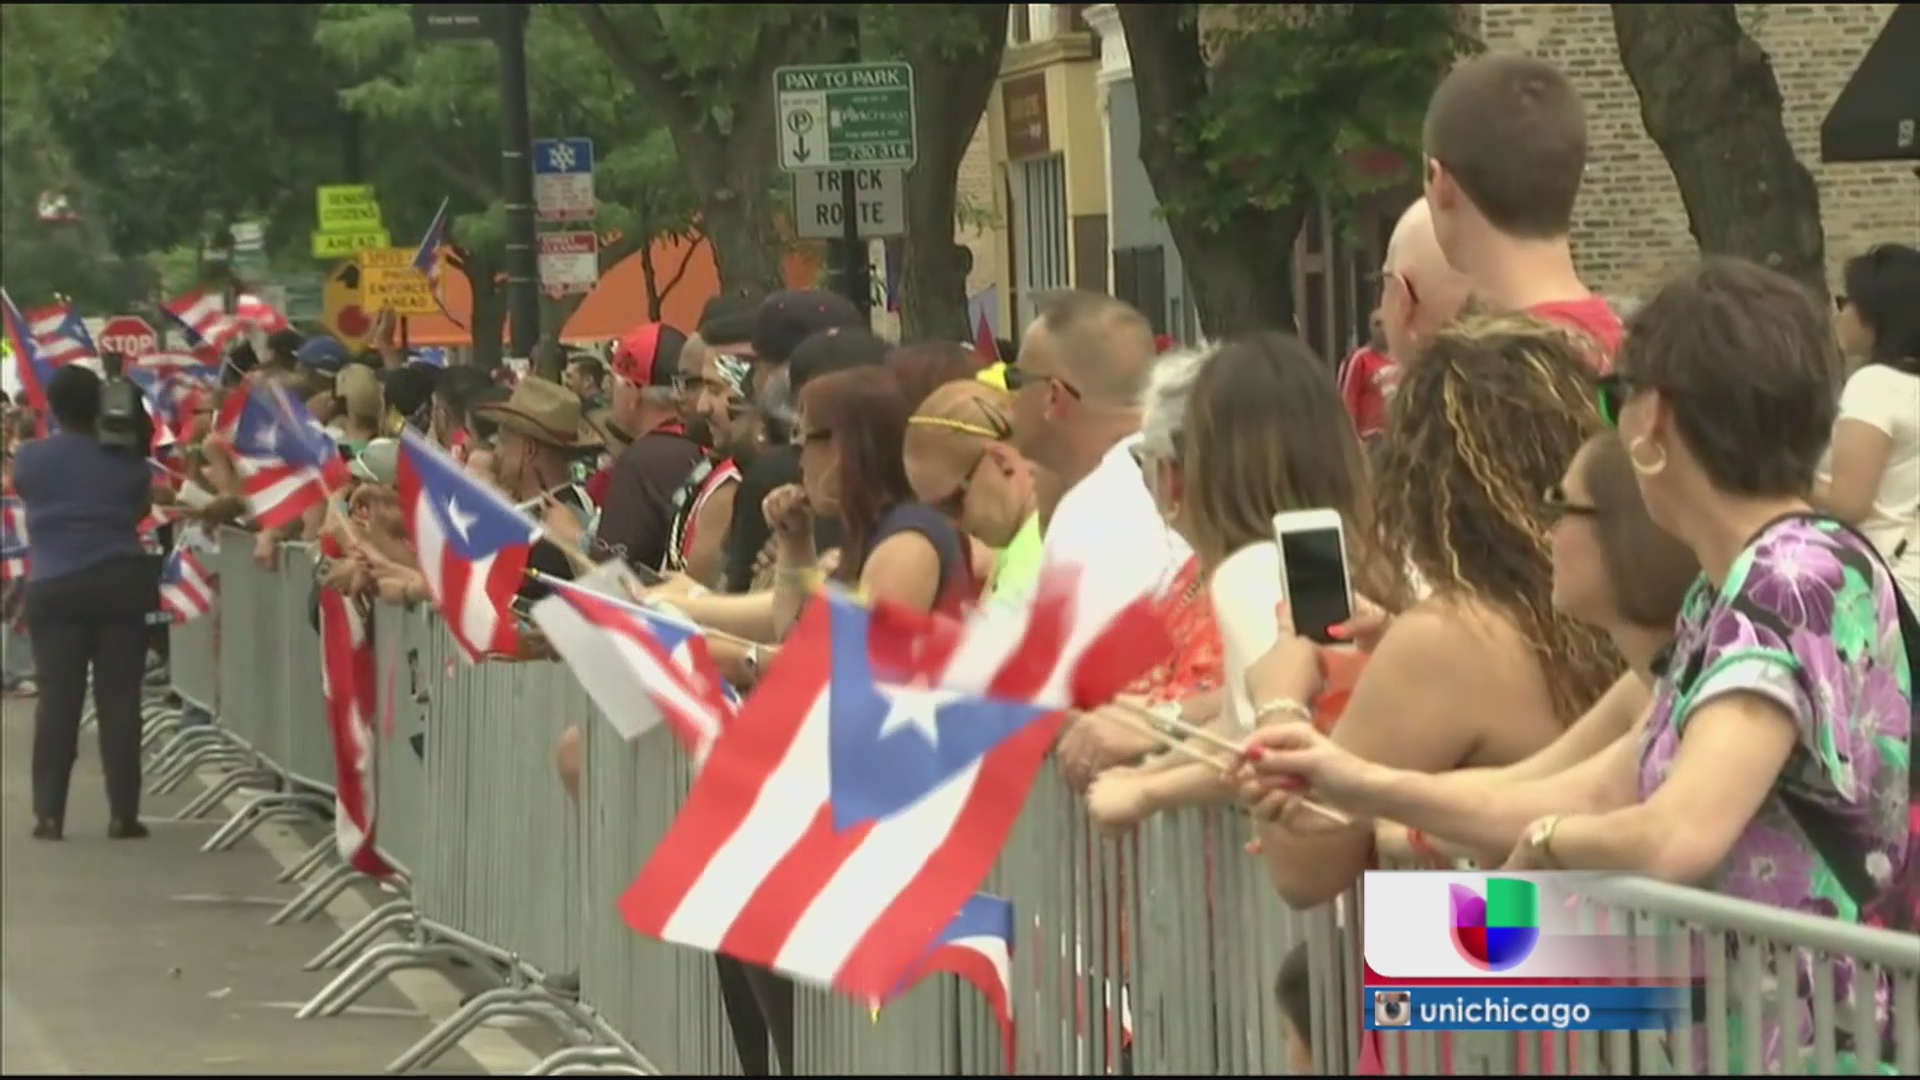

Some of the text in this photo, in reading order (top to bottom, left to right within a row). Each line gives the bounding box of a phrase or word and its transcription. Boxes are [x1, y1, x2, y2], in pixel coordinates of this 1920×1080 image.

[785, 69, 899, 88] PAY TO PARK
[815, 169, 882, 191] TRCK
[816, 202, 884, 225] ROTE
[326, 236, 377, 249] AHEAD
[101, 334, 154, 357] STOP
